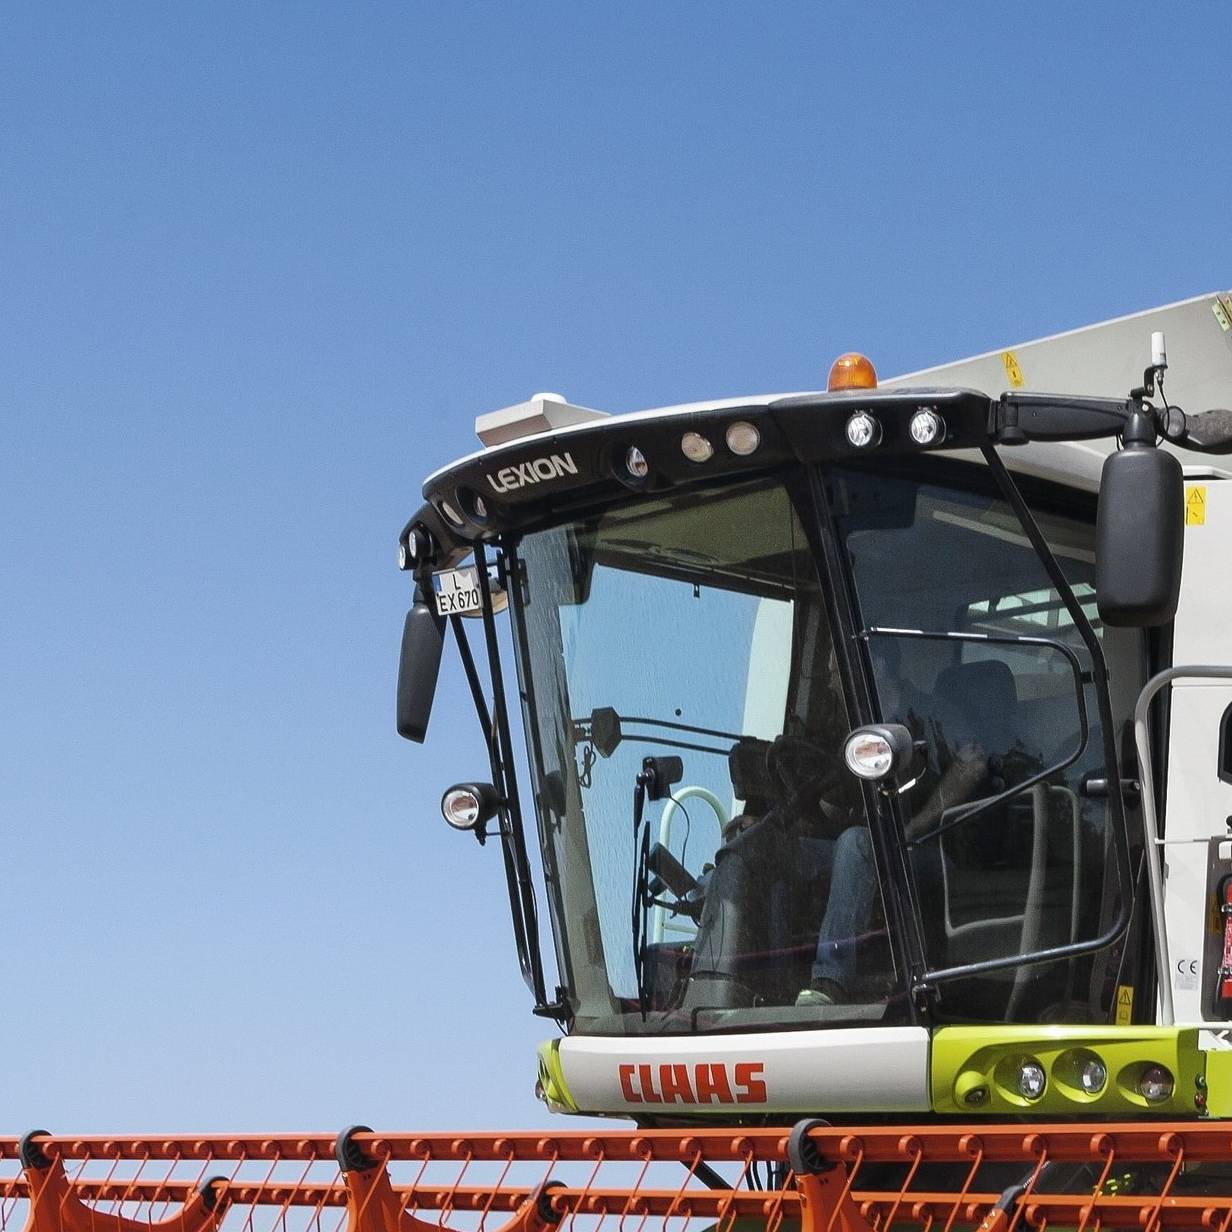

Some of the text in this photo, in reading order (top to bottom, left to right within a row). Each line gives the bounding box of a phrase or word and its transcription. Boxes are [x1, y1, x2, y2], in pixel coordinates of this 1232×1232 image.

[486, 452, 578, 493] LEXION
[452, 573, 461, 590] L
[619, 1063, 768, 1104] CLAAS
